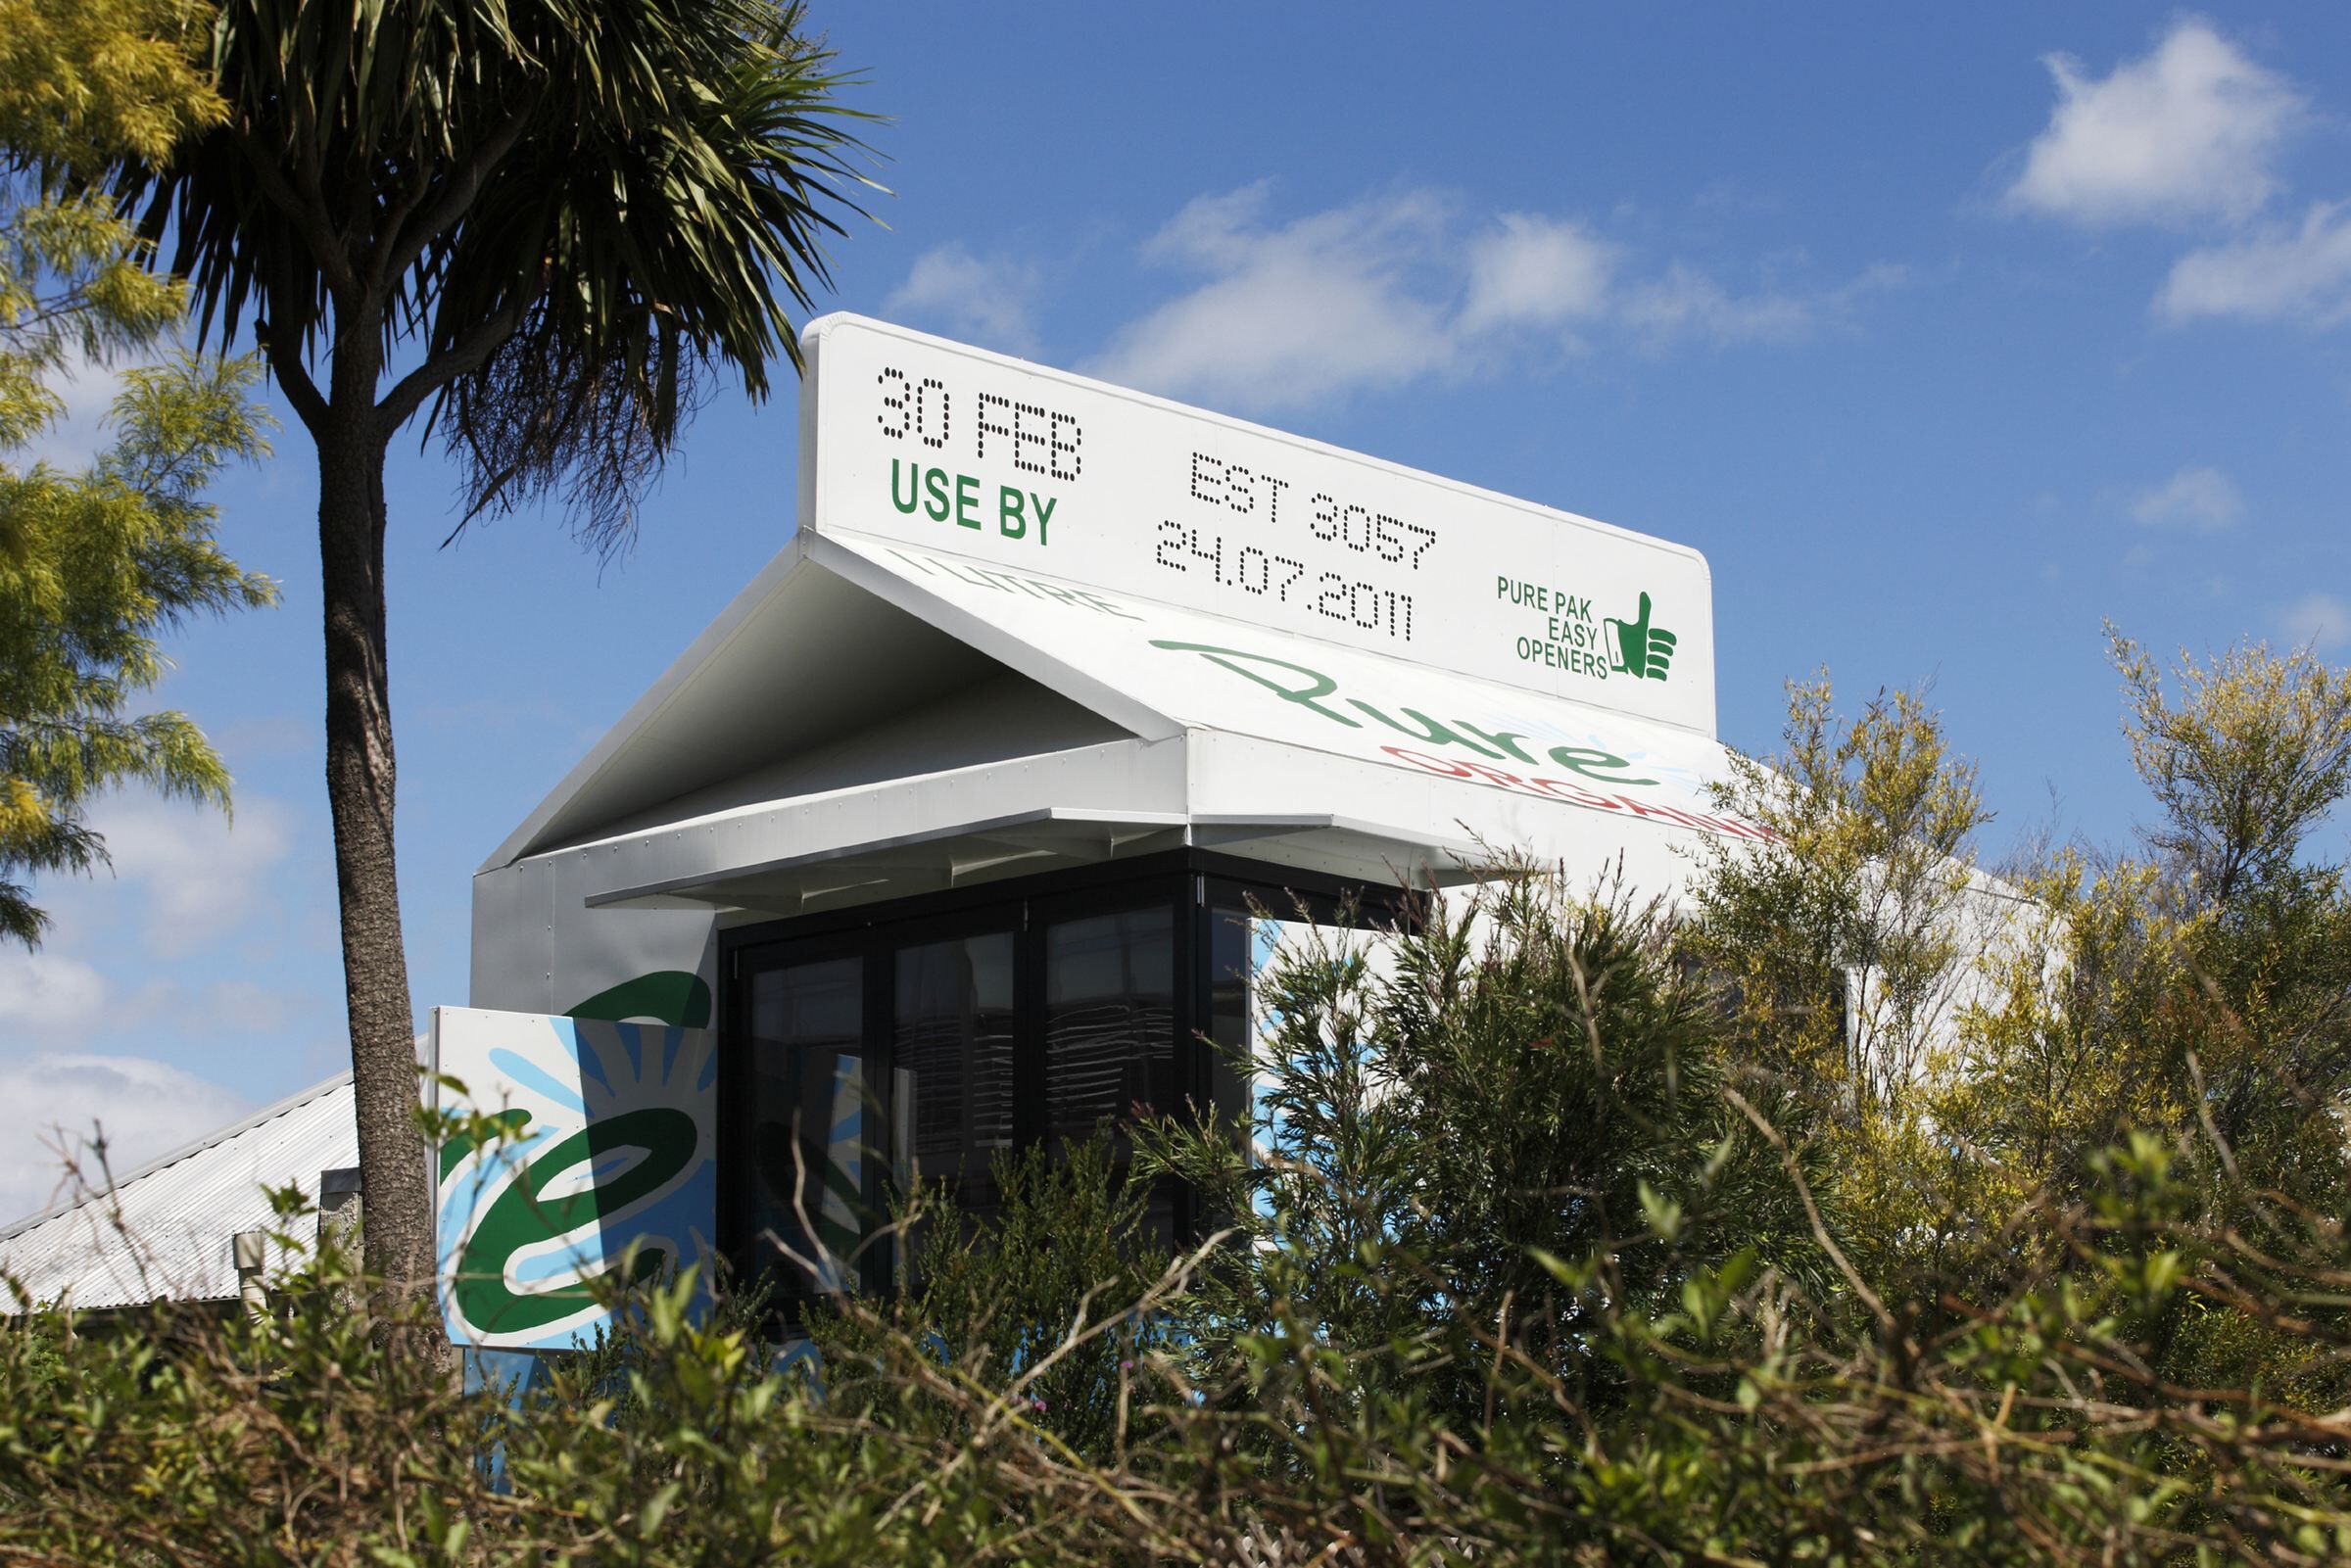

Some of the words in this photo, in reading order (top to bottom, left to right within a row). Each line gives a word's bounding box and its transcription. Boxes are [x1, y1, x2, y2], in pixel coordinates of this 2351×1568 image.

[878, 366, 950, 449] 30
[978, 392, 1081, 482] FEB
[891, 457, 982, 531] USE
[1000, 485, 1058, 546] BY
[1190, 451, 1289, 523] EST
[1310, 493, 1437, 570] 3057
[1156, 520, 1413, 641] 24.07.2011
[1497, 575, 1549, 612] PURE
[1555, 591, 1593, 624] PAK
[1516, 636, 1607, 680] OPENERS
[1548, 616, 1598, 650] EASY
[1148, 640, 1661, 785] Pure
